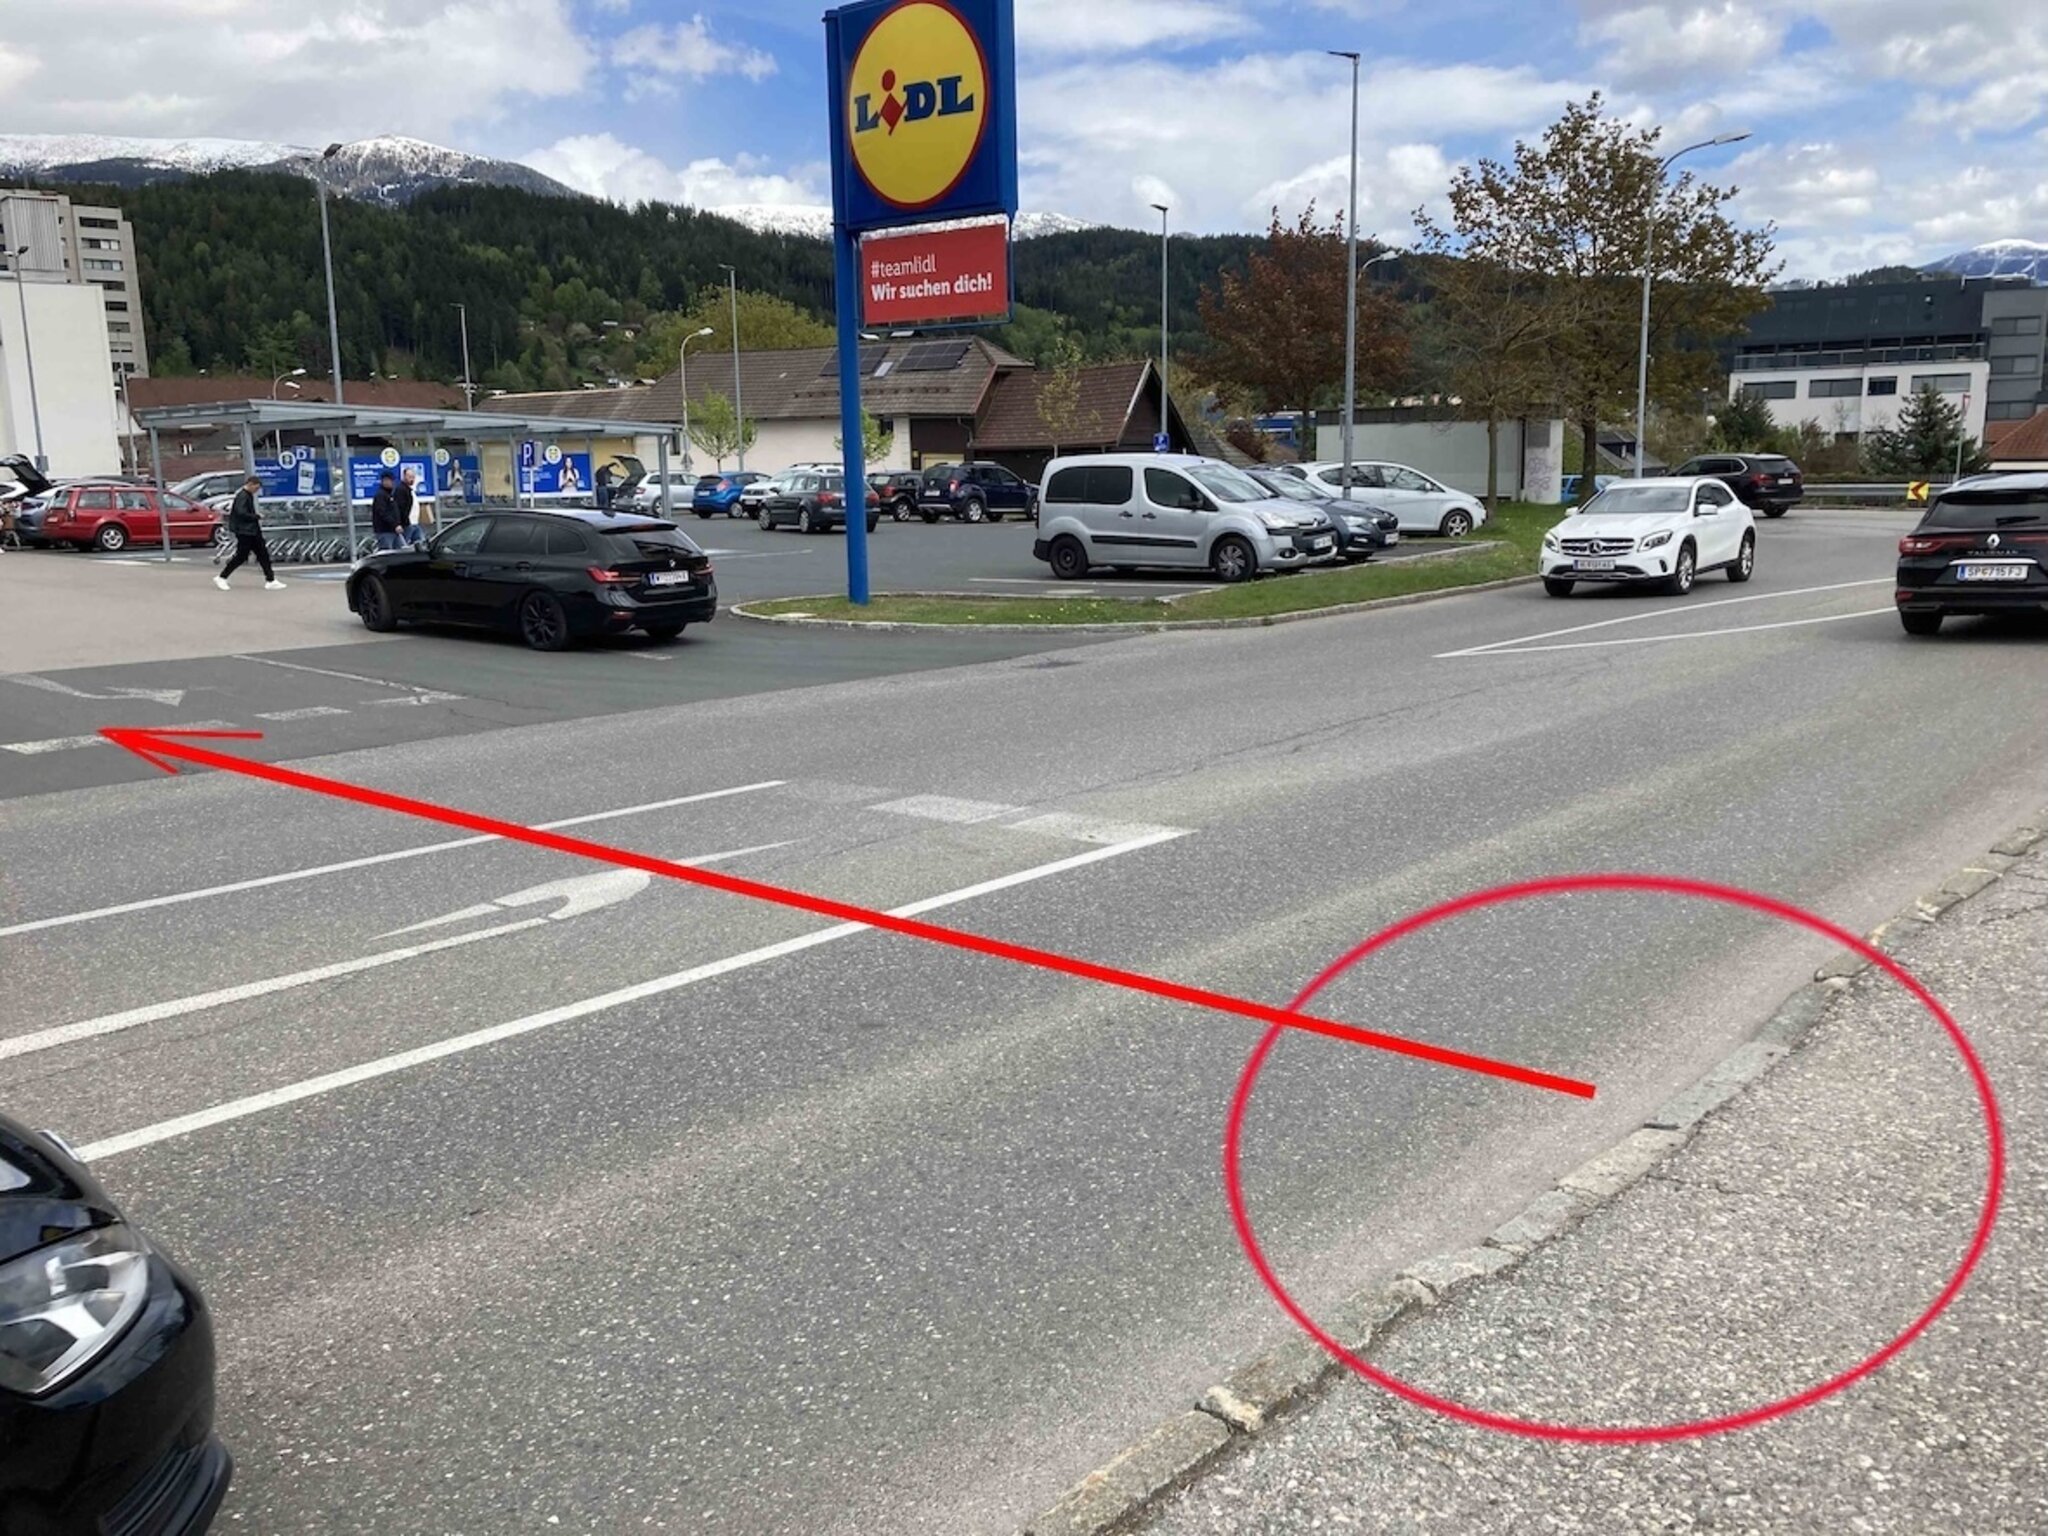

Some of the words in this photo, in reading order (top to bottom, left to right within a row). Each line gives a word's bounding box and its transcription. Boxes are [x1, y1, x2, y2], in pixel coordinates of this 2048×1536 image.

[871, 253, 936, 278] #teamlidl
[871, 282, 897, 301] Wir
[899, 279, 950, 299] suchen
[953, 272, 992, 295] dich!
